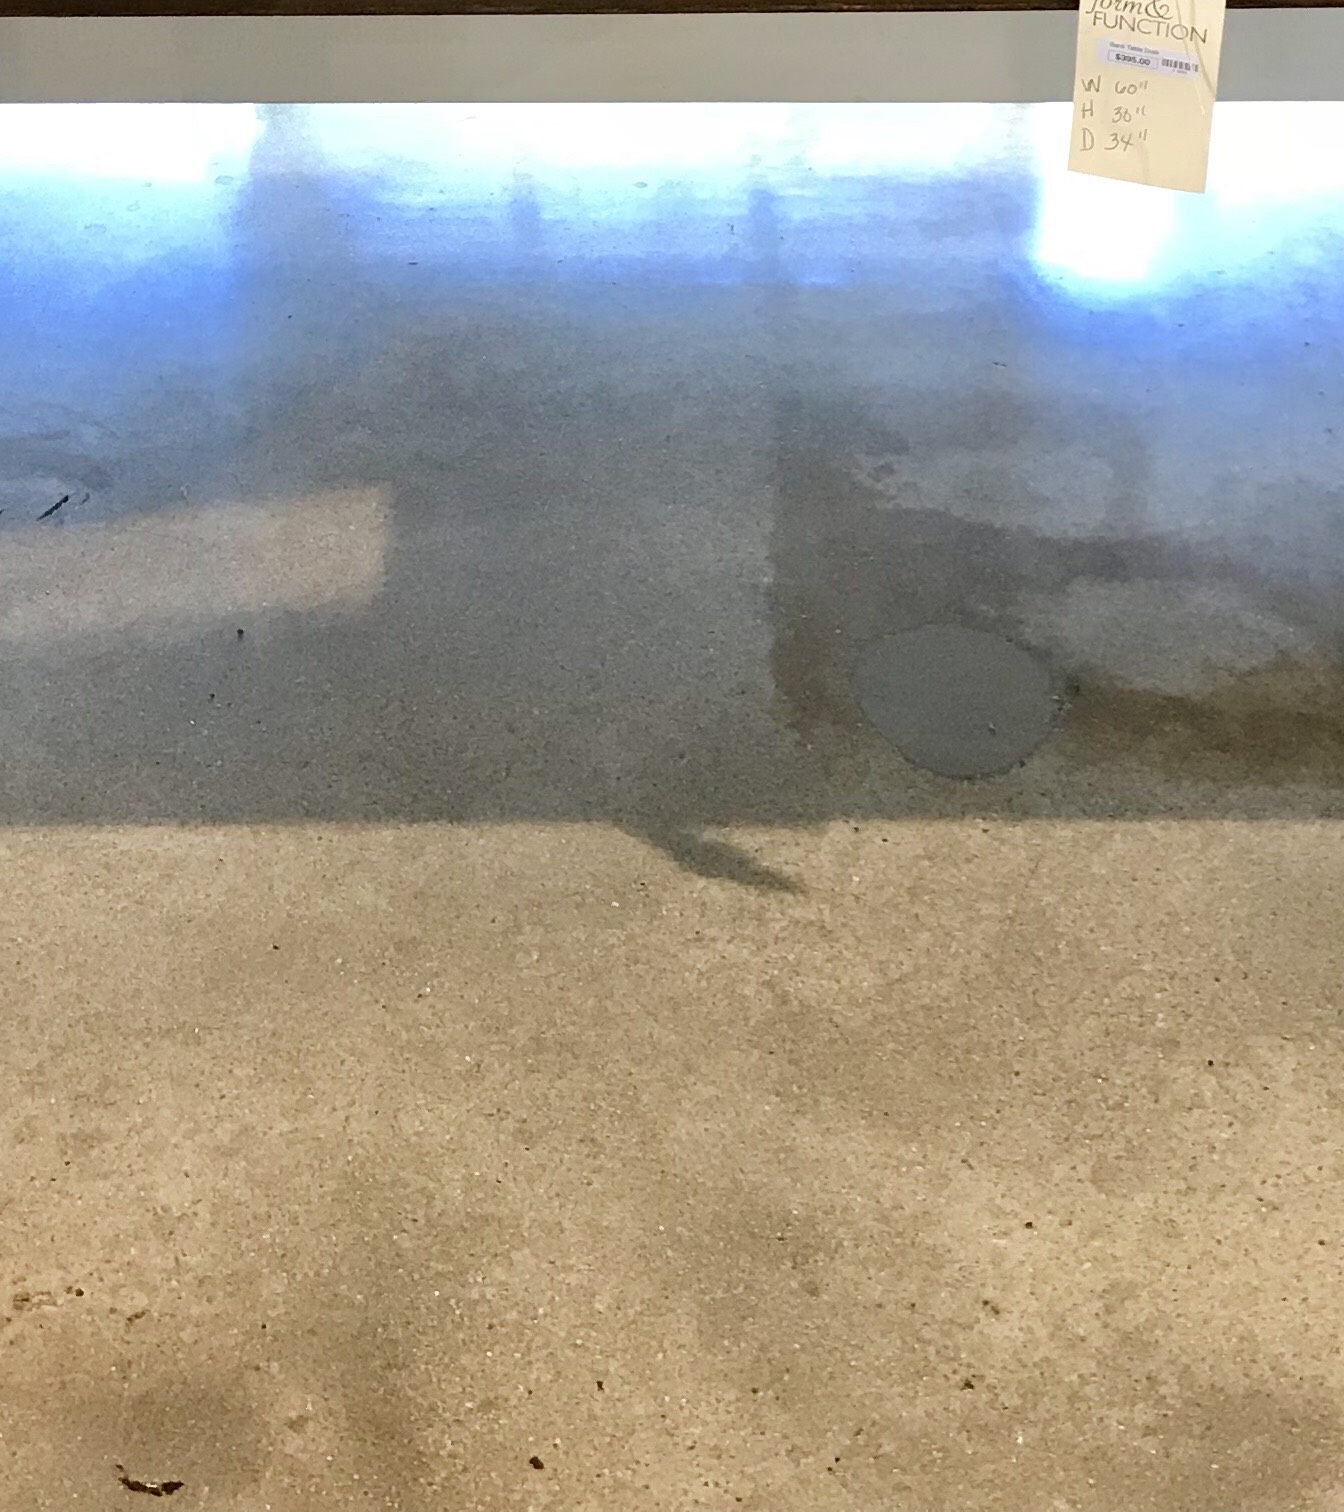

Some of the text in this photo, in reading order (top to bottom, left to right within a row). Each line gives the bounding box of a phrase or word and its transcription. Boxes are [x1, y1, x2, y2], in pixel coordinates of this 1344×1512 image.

[1092, 10, 1208, 44] FUNCTION
[1081, 74, 1101, 93] W
[1081, 99, 1094, 119] H
[1079, 127, 1095, 151] D
